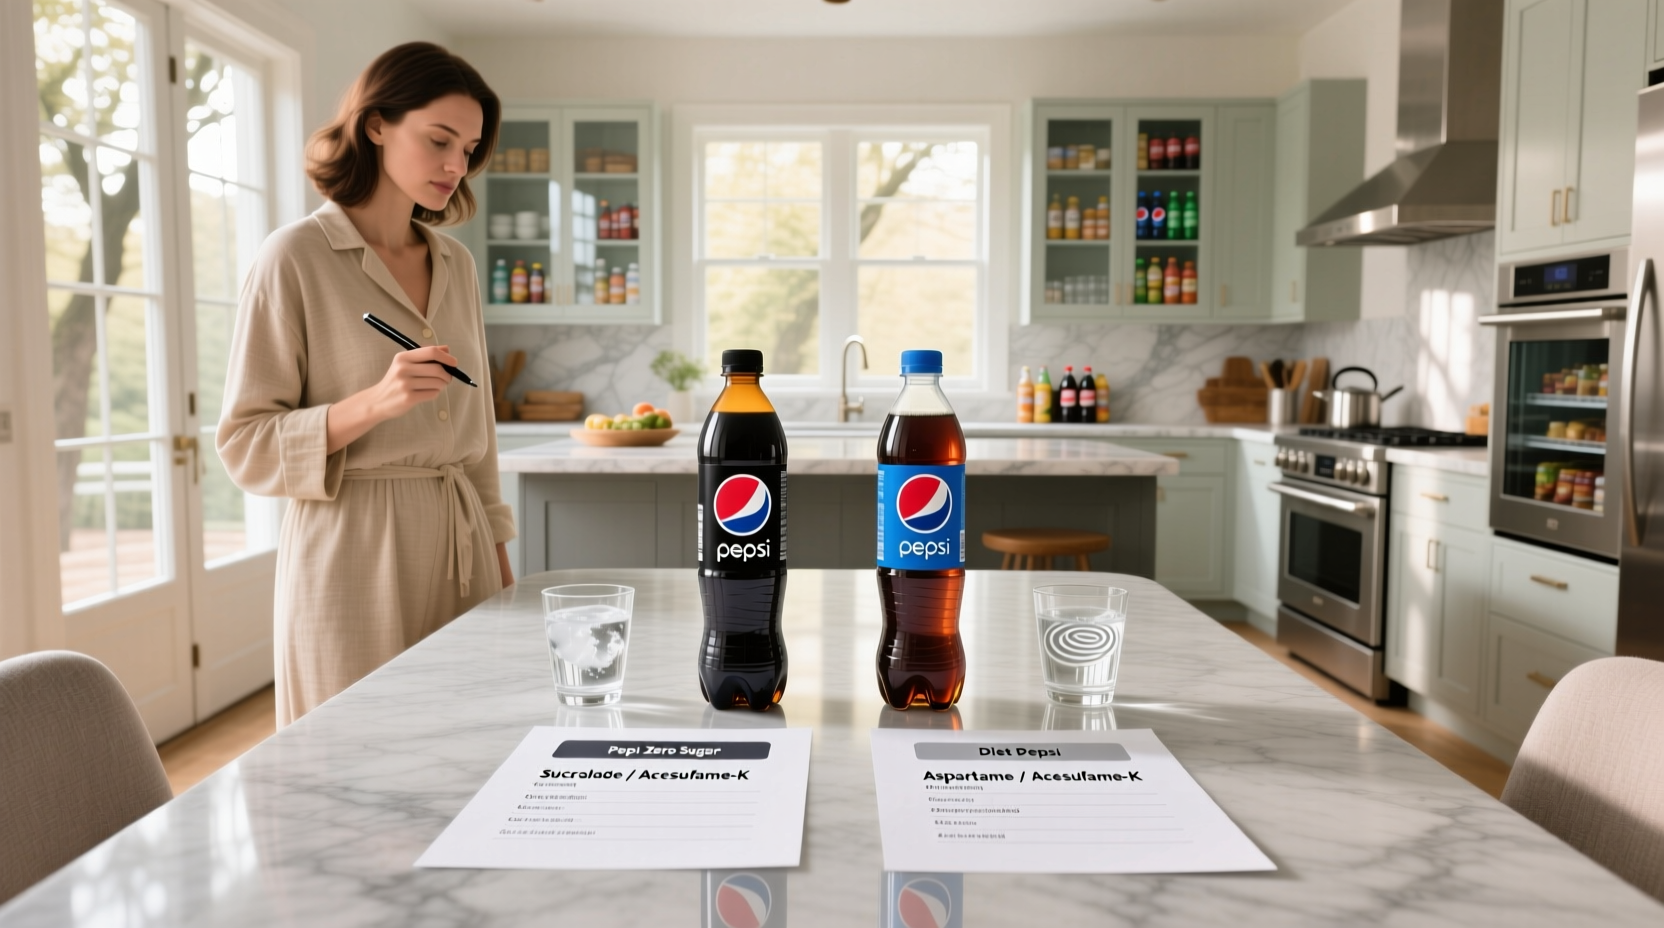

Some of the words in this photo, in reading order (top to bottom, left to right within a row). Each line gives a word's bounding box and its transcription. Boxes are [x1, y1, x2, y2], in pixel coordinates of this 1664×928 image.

[716, 538, 771, 563] pepsi
[899, 538, 951, 561] pepsi
[642, 745, 677, 756] Zero
[679, 745, 721, 758] Sugar
[978, 747, 1013, 757] Diet
[625, 769, 636, 782] /
[923, 771, 1014, 784] Aspartame
[1019, 771, 1026, 783] /
